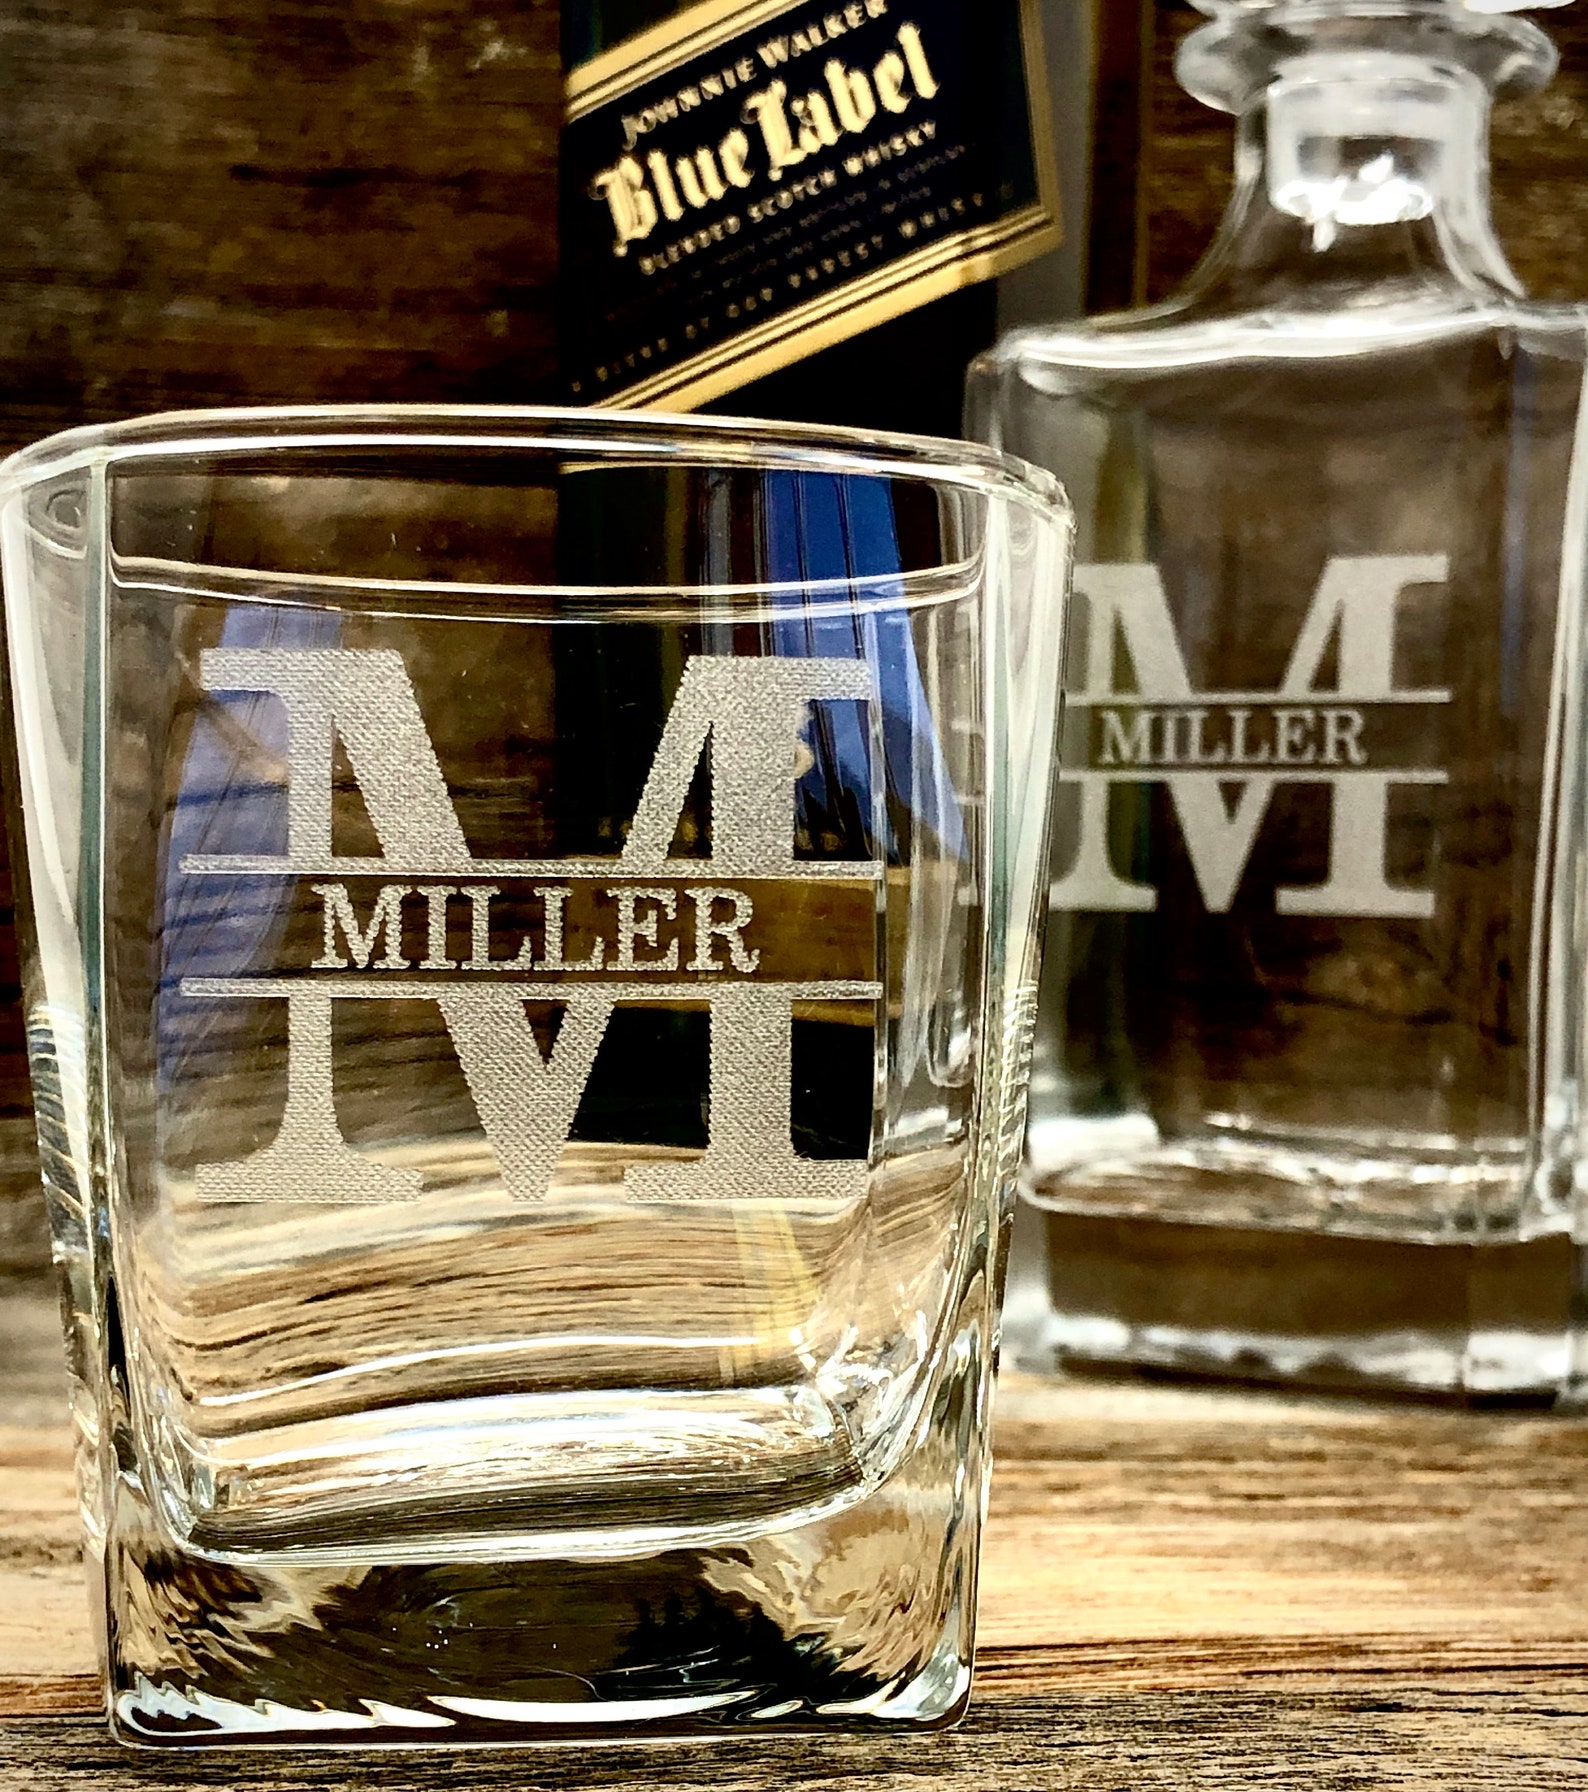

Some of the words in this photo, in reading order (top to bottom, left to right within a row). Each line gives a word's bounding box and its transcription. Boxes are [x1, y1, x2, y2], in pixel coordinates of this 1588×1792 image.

[589, 126, 754, 258] Blue
[740, 20, 940, 181] Label
[621, 57, 757, 150] JOHNNIE
[756, 0, 889, 68] WALKER
[747, 166, 838, 223] SCOTCH
[841, 118, 937, 177] WHISKY
[1049, 554, 1453, 919] M
[1099, 708, 1369, 766] MILLER
[180, 648, 884, 1204] M
[310, 883, 761, 974] MILLER
